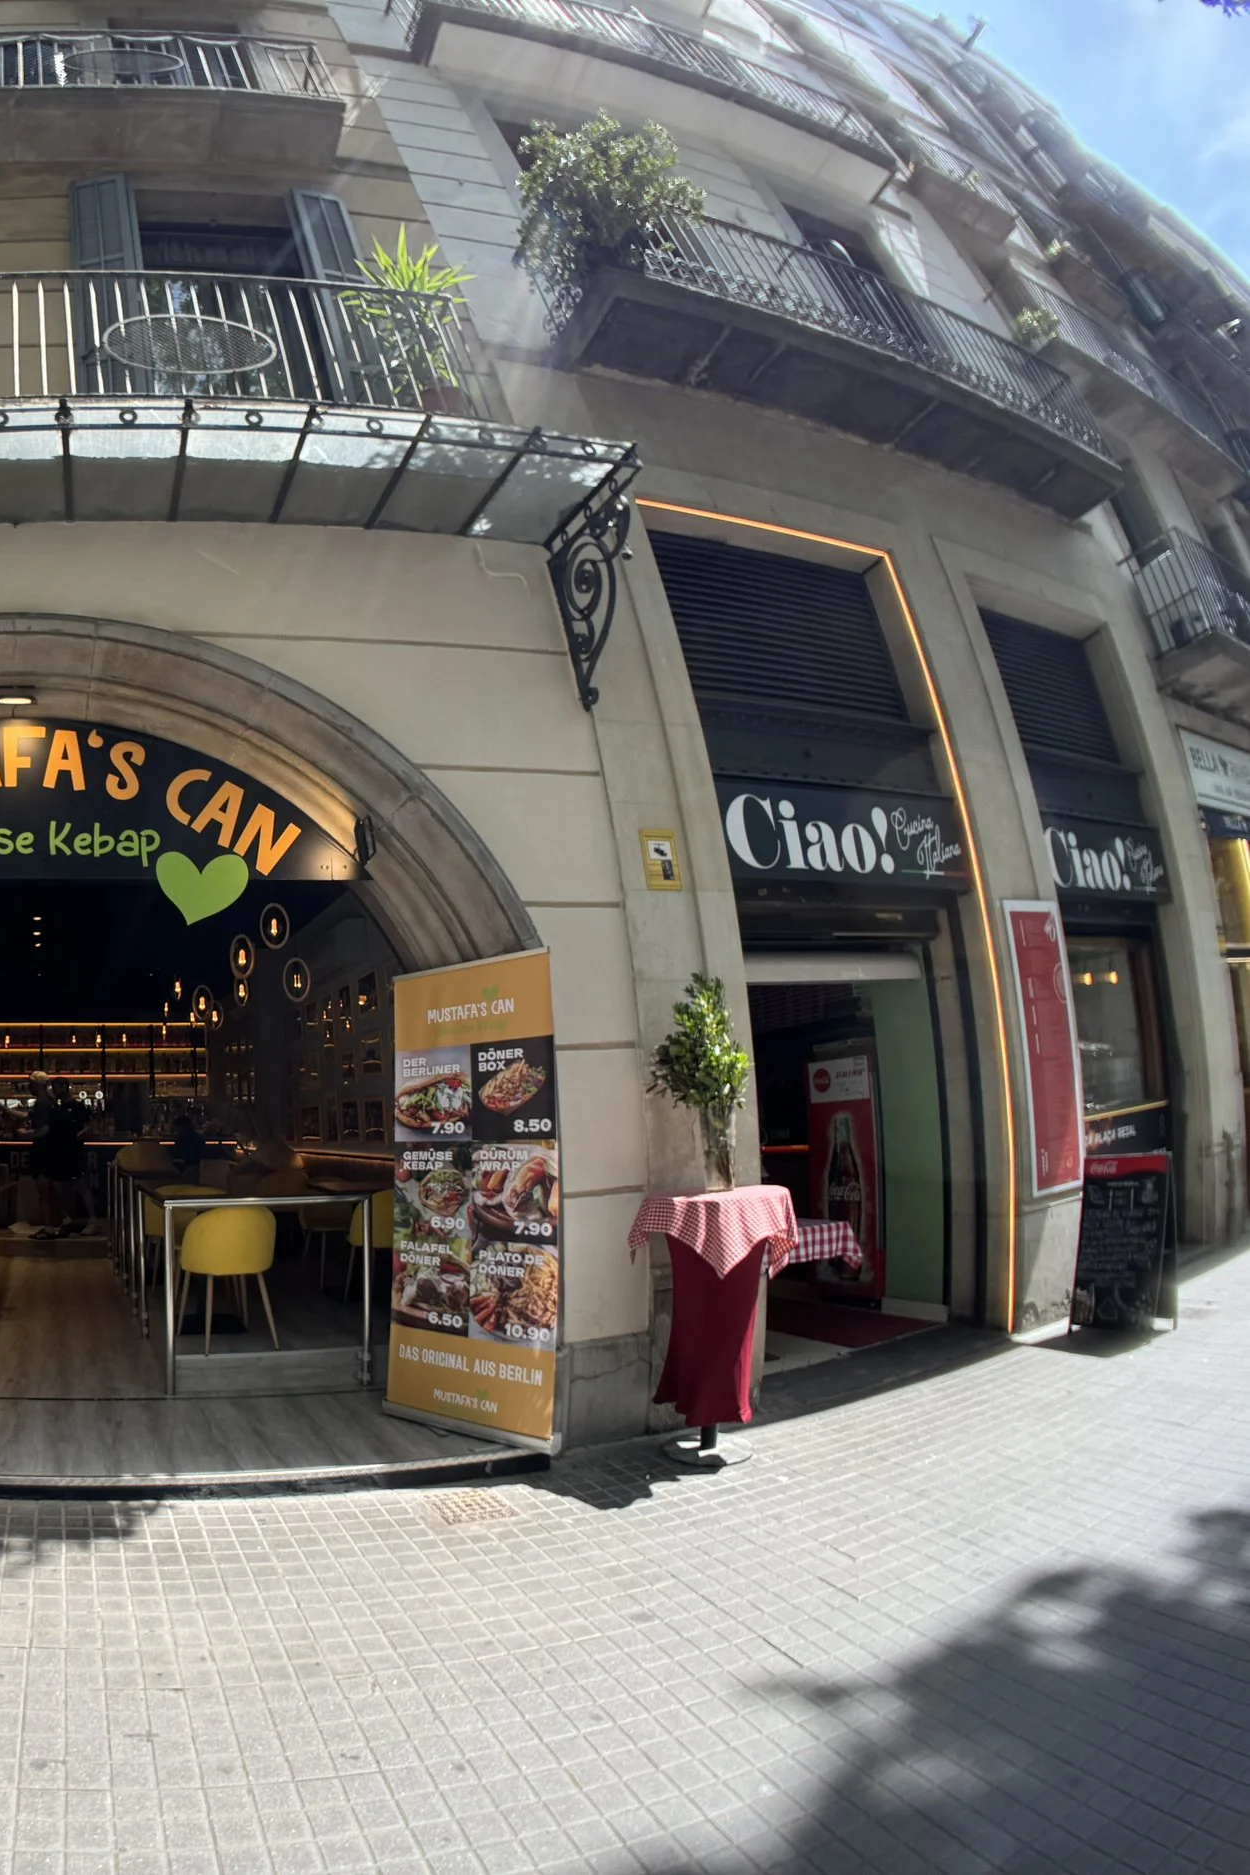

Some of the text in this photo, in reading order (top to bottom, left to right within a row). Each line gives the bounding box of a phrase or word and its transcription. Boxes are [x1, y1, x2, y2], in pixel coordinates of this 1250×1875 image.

[166, 769, 302, 876] CAN
[891, 807, 935, 851] Cucina
[725, 793, 895, 875] Ciao!
[49, 821, 161, 867] Kebap
[1044, 826, 1131, 891] Ciao!
[427, 998, 514, 1025] MUSTAFA'S CAN
[403, 1057, 427, 1068] DER
[478, 1048, 524, 1062] DÖNER
[403, 1064, 461, 1077] BERLINER
[478, 1060, 506, 1072] BOX
[431, 1121, 465, 1134] 7.90
[513, 1118, 552, 1133] 8.50
[403, 1148, 453, 1161] GEMÜSE
[480, 1147, 528, 1160] DÜRÜM
[403, 1160, 443, 1171] KEBAP
[480, 1160, 521, 1172] WRAP
[430, 1216, 465, 1230] 6.90
[513, 1221, 553, 1236] 7.90
[400, 1240, 452, 1255] FALAFEL
[400, 1252, 441, 1266] DÖNER
[478, 1250, 544, 1265] PLATO DE
[478, 1263, 525, 1277] DÖNER
[428, 1311, 462, 1327] 6.50
[504, 1322, 551, 1342] 10.90
[399, 1343, 543, 1386] DAS ORIGINAL AUS BERLIN
[433, 1388, 478, 1408] MUSTAFA'S
[480, 1400, 498, 1413] CAN
